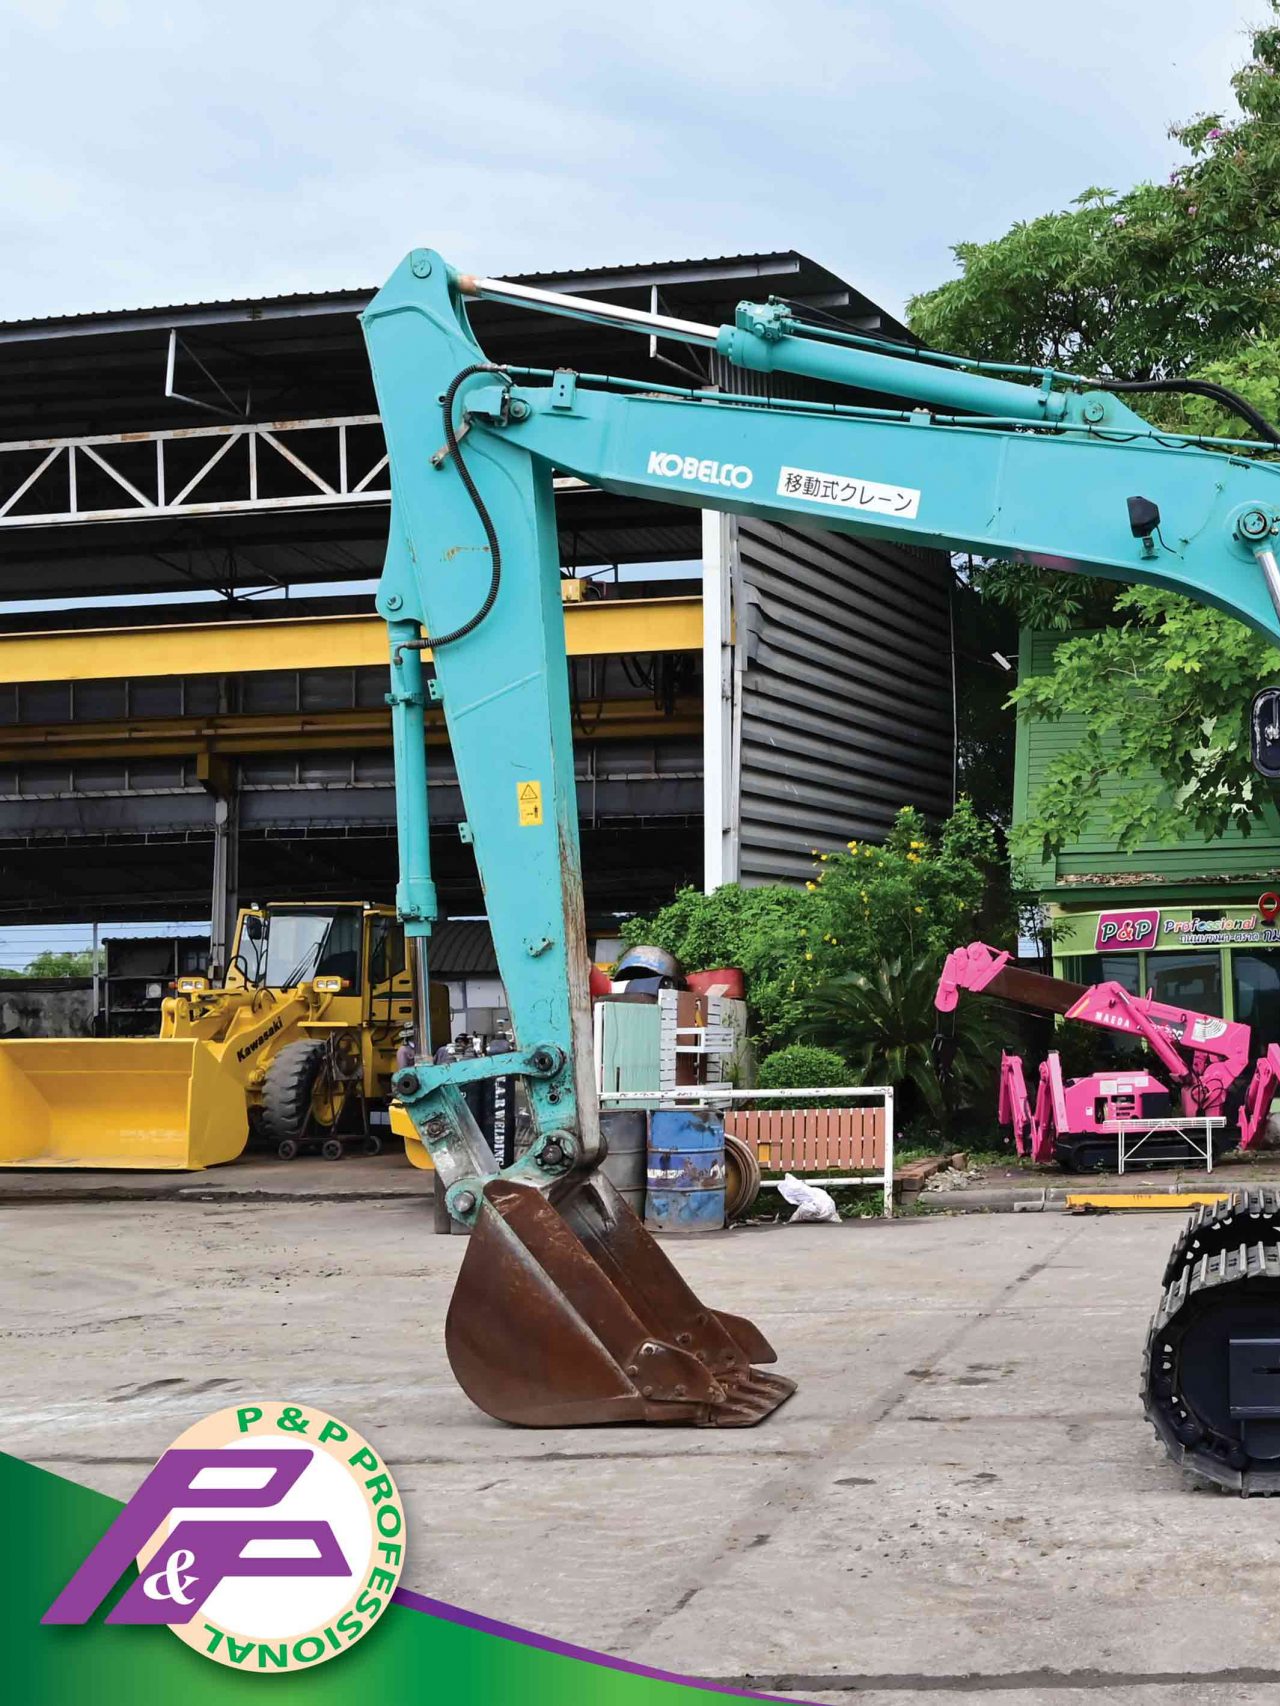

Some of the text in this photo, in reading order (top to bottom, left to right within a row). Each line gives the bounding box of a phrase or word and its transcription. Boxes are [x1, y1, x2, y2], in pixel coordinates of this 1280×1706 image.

[648, 451, 753, 489] KOBELCO
[785, 472, 913, 512] 移動式クレーン
[1101, 920, 1152, 942] P&P
[1164, 915, 1256, 932] Professional
[1095, 1011, 1130, 1029] MAEDA
[237, 1016, 283, 1063] Kawasaki
